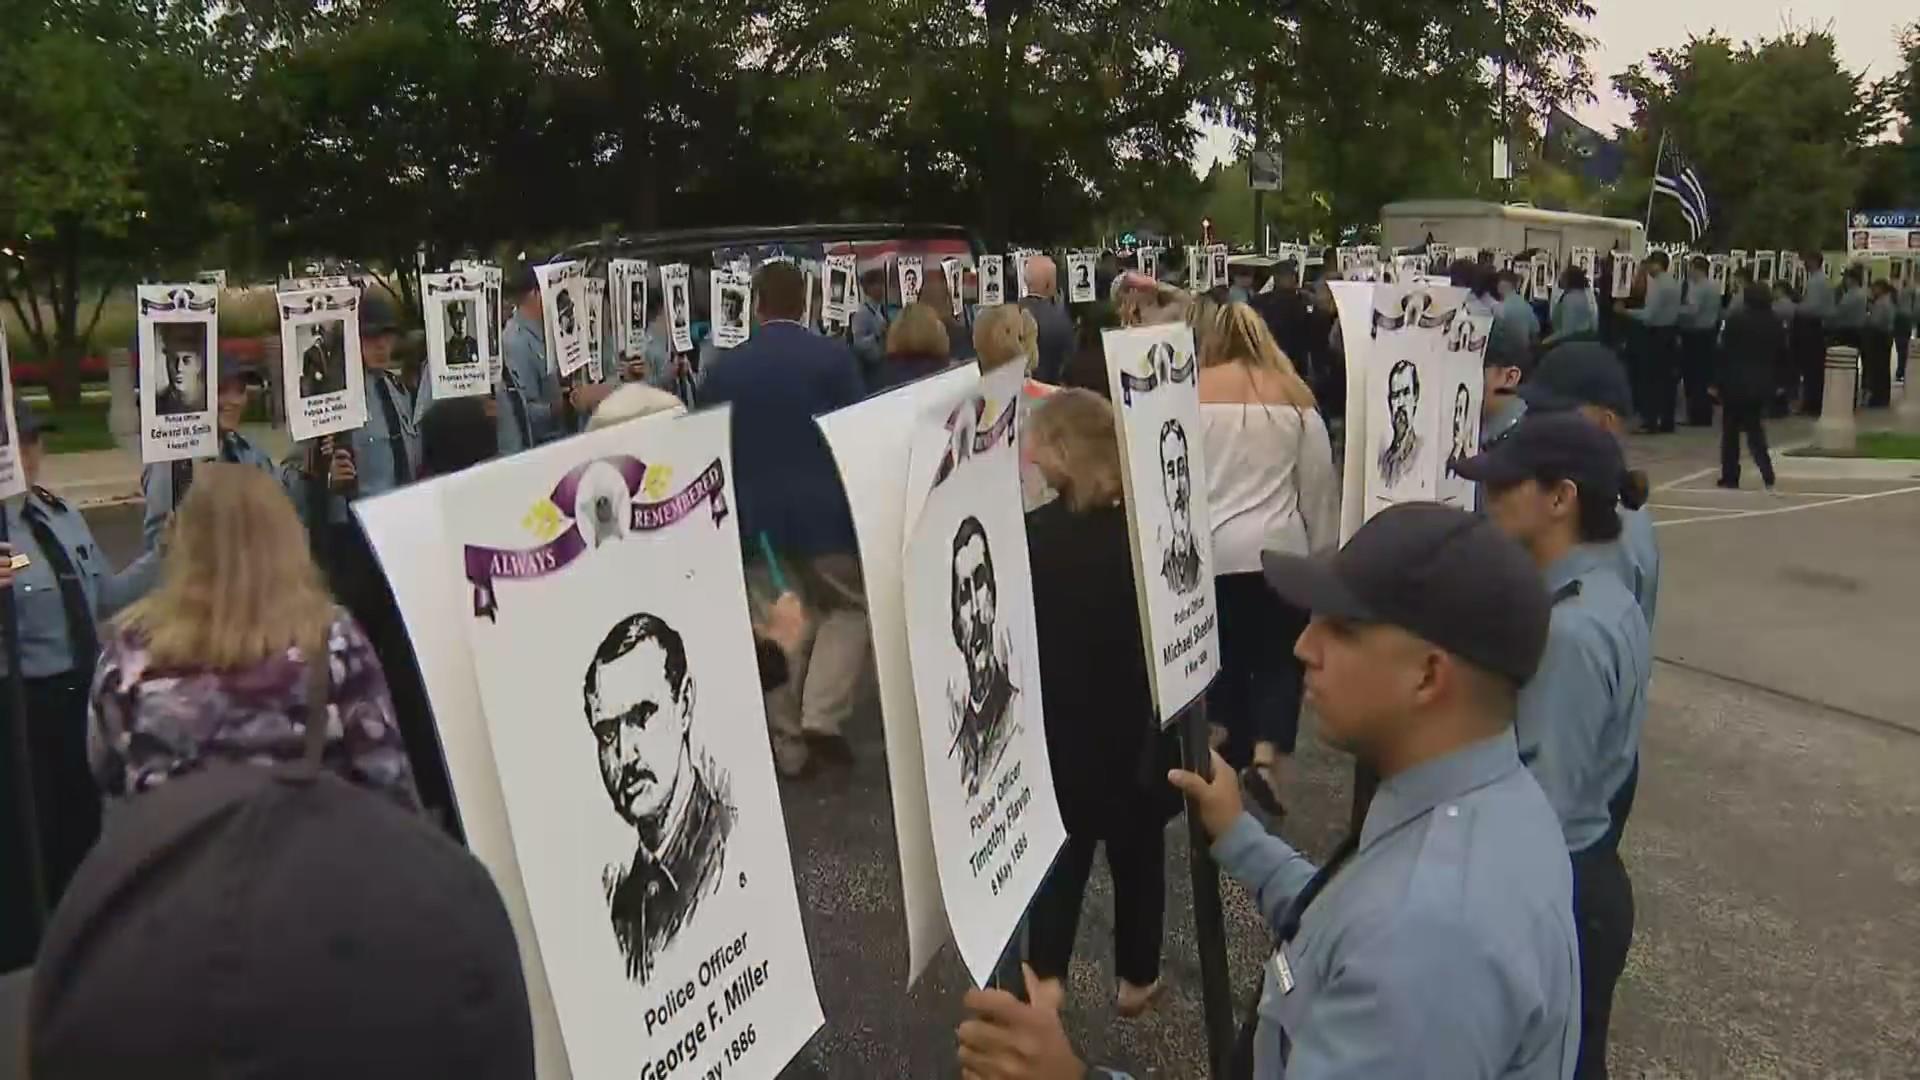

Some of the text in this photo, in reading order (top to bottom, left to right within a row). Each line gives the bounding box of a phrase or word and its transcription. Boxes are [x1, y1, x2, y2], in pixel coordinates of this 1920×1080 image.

[634, 468, 720, 528] REMEMBERED
[490, 549, 556, 577] ALWAYS
[1163, 628, 1193, 667] Michael
[969, 785, 1032, 878] Timothy Flavin
[970, 760, 1021, 838] Police Officer
[644, 931, 748, 1037] Police Officer
[641, 959, 769, 1080] George F. Miller
[723, 1023, 757, 1067] 1886
